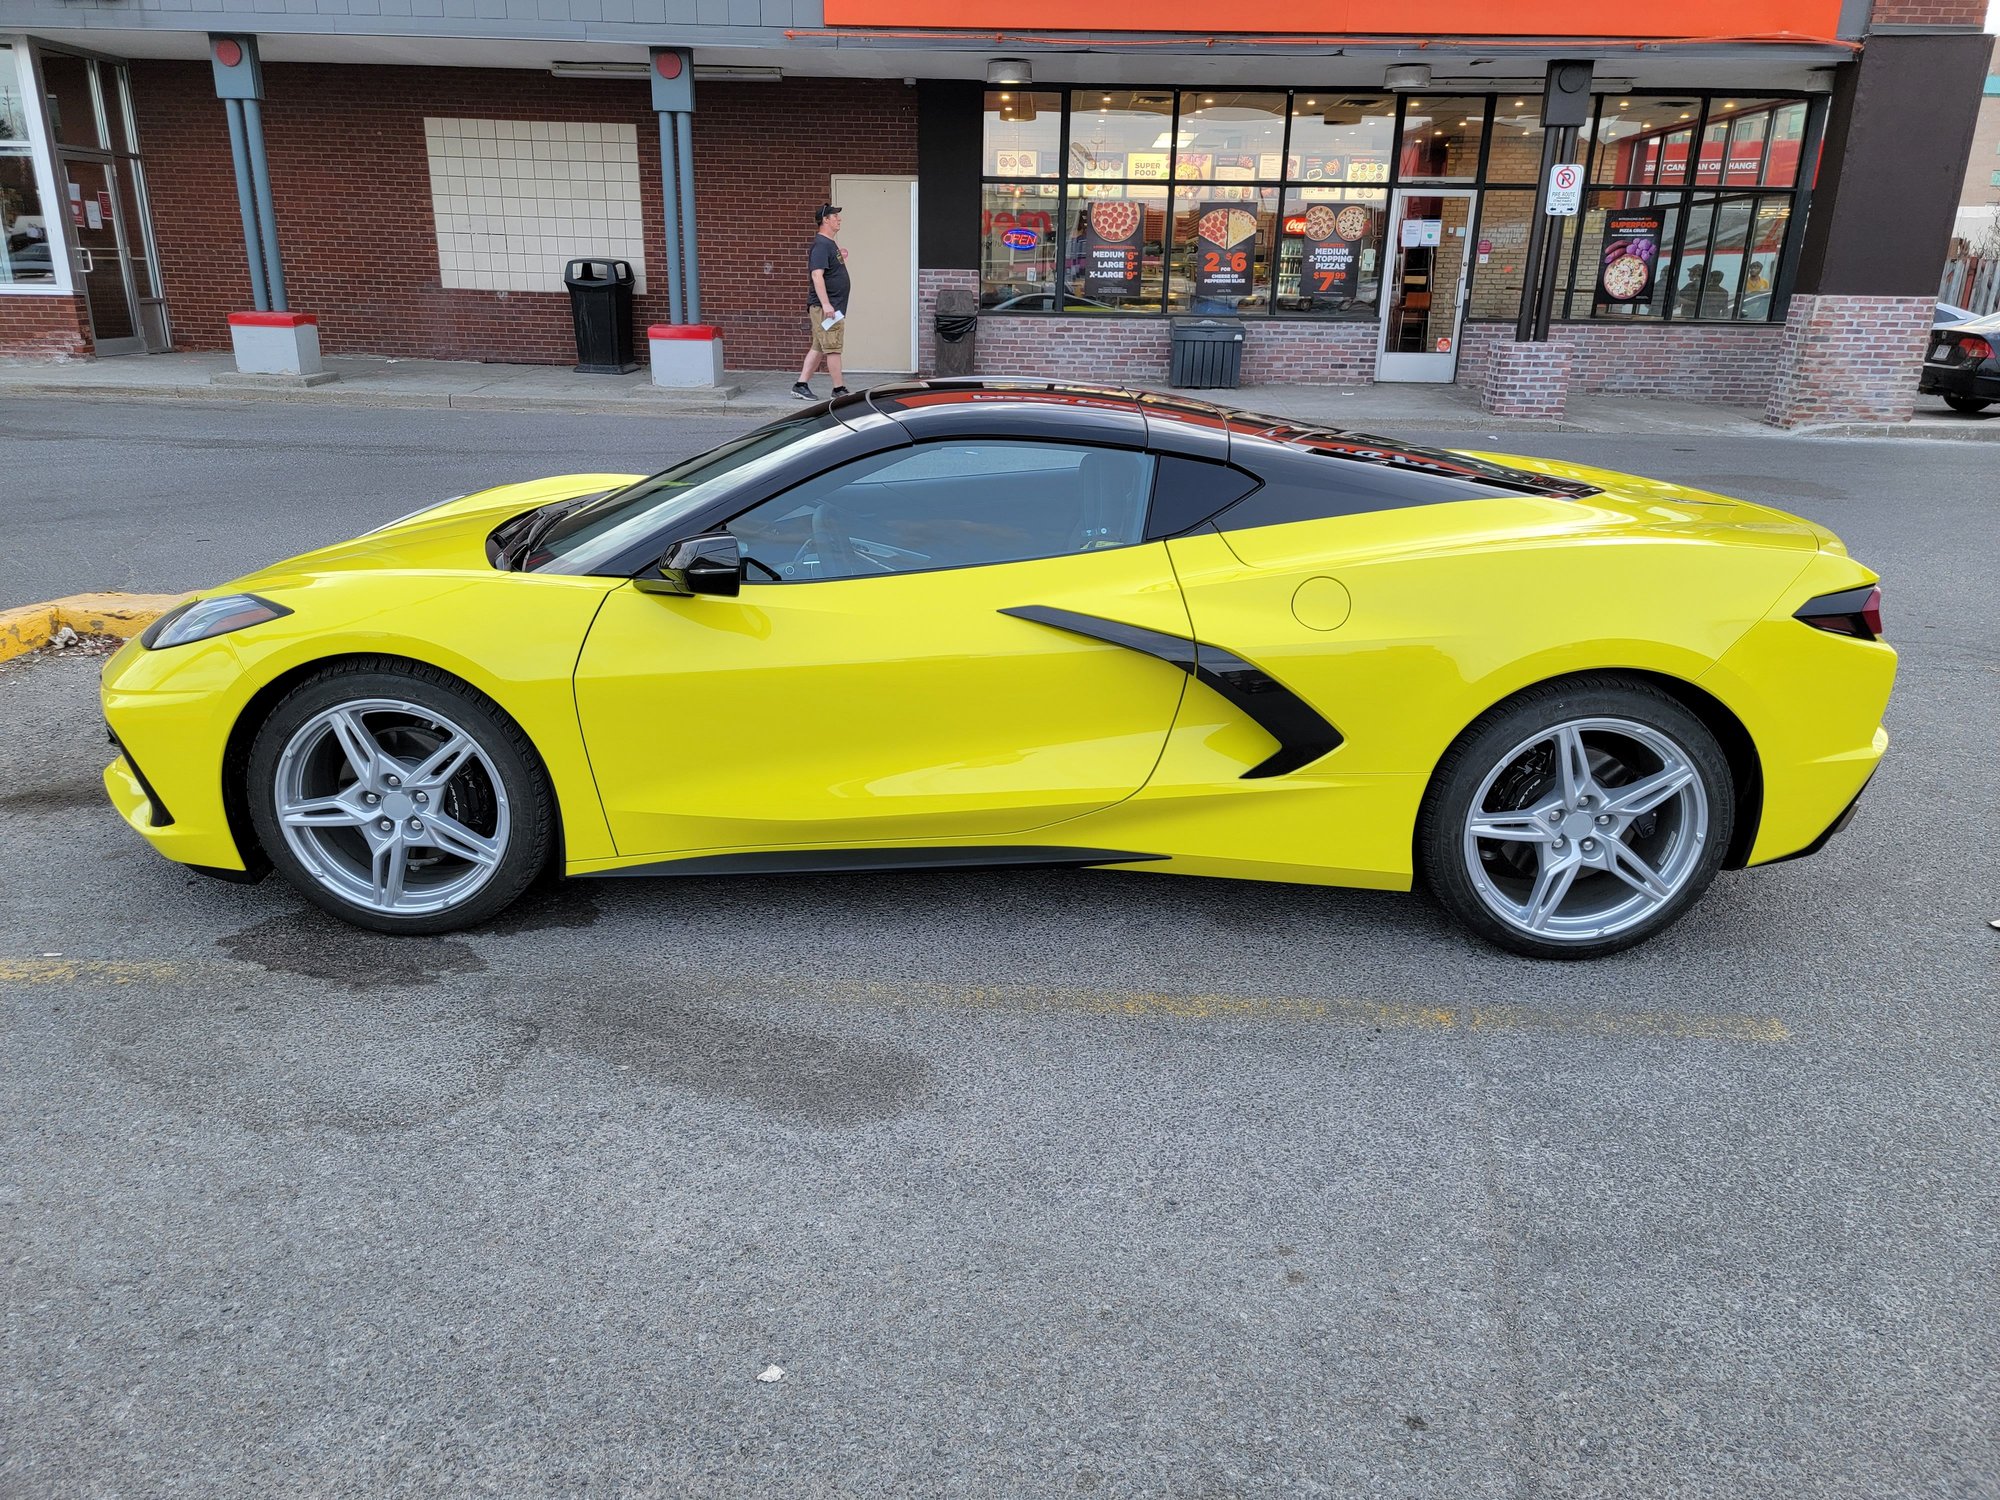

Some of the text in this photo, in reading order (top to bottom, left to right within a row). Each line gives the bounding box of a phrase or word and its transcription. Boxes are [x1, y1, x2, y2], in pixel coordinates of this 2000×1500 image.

[1728, 162, 1757, 170] HANGE
[1610, 221, 1658, 229] SUPERFOOD
[1003, 234, 1036, 246] OPEN
[1203, 252, 1220, 272] 2
